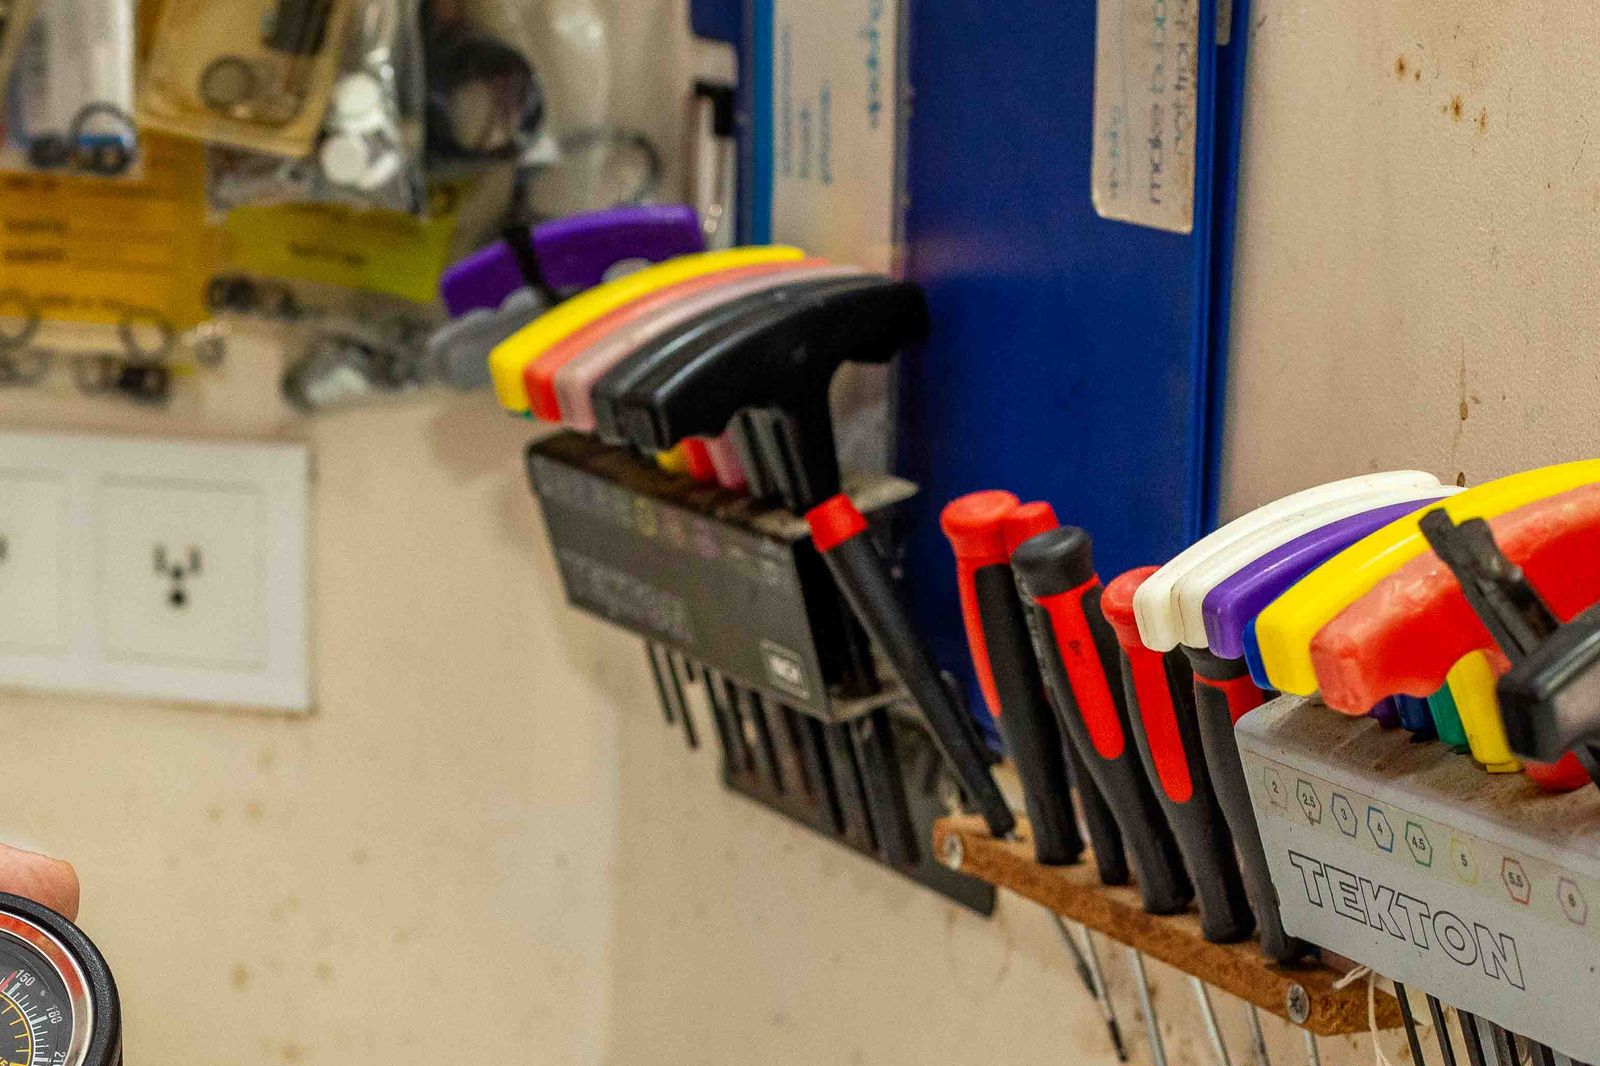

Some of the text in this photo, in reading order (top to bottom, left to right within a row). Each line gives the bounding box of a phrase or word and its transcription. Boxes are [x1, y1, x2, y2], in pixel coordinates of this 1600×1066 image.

[1271, 780, 1279, 794] 2
[1302, 793, 1316, 808] 2.5
[1340, 808, 1348, 821] 3
[1376, 822, 1383, 835] 4
[1412, 836, 1426, 851] 4.5
[1460, 853, 1468, 867] 5
[1287, 849, 1526, 991] TEKTON
[15, 969, 36, 987] 150
